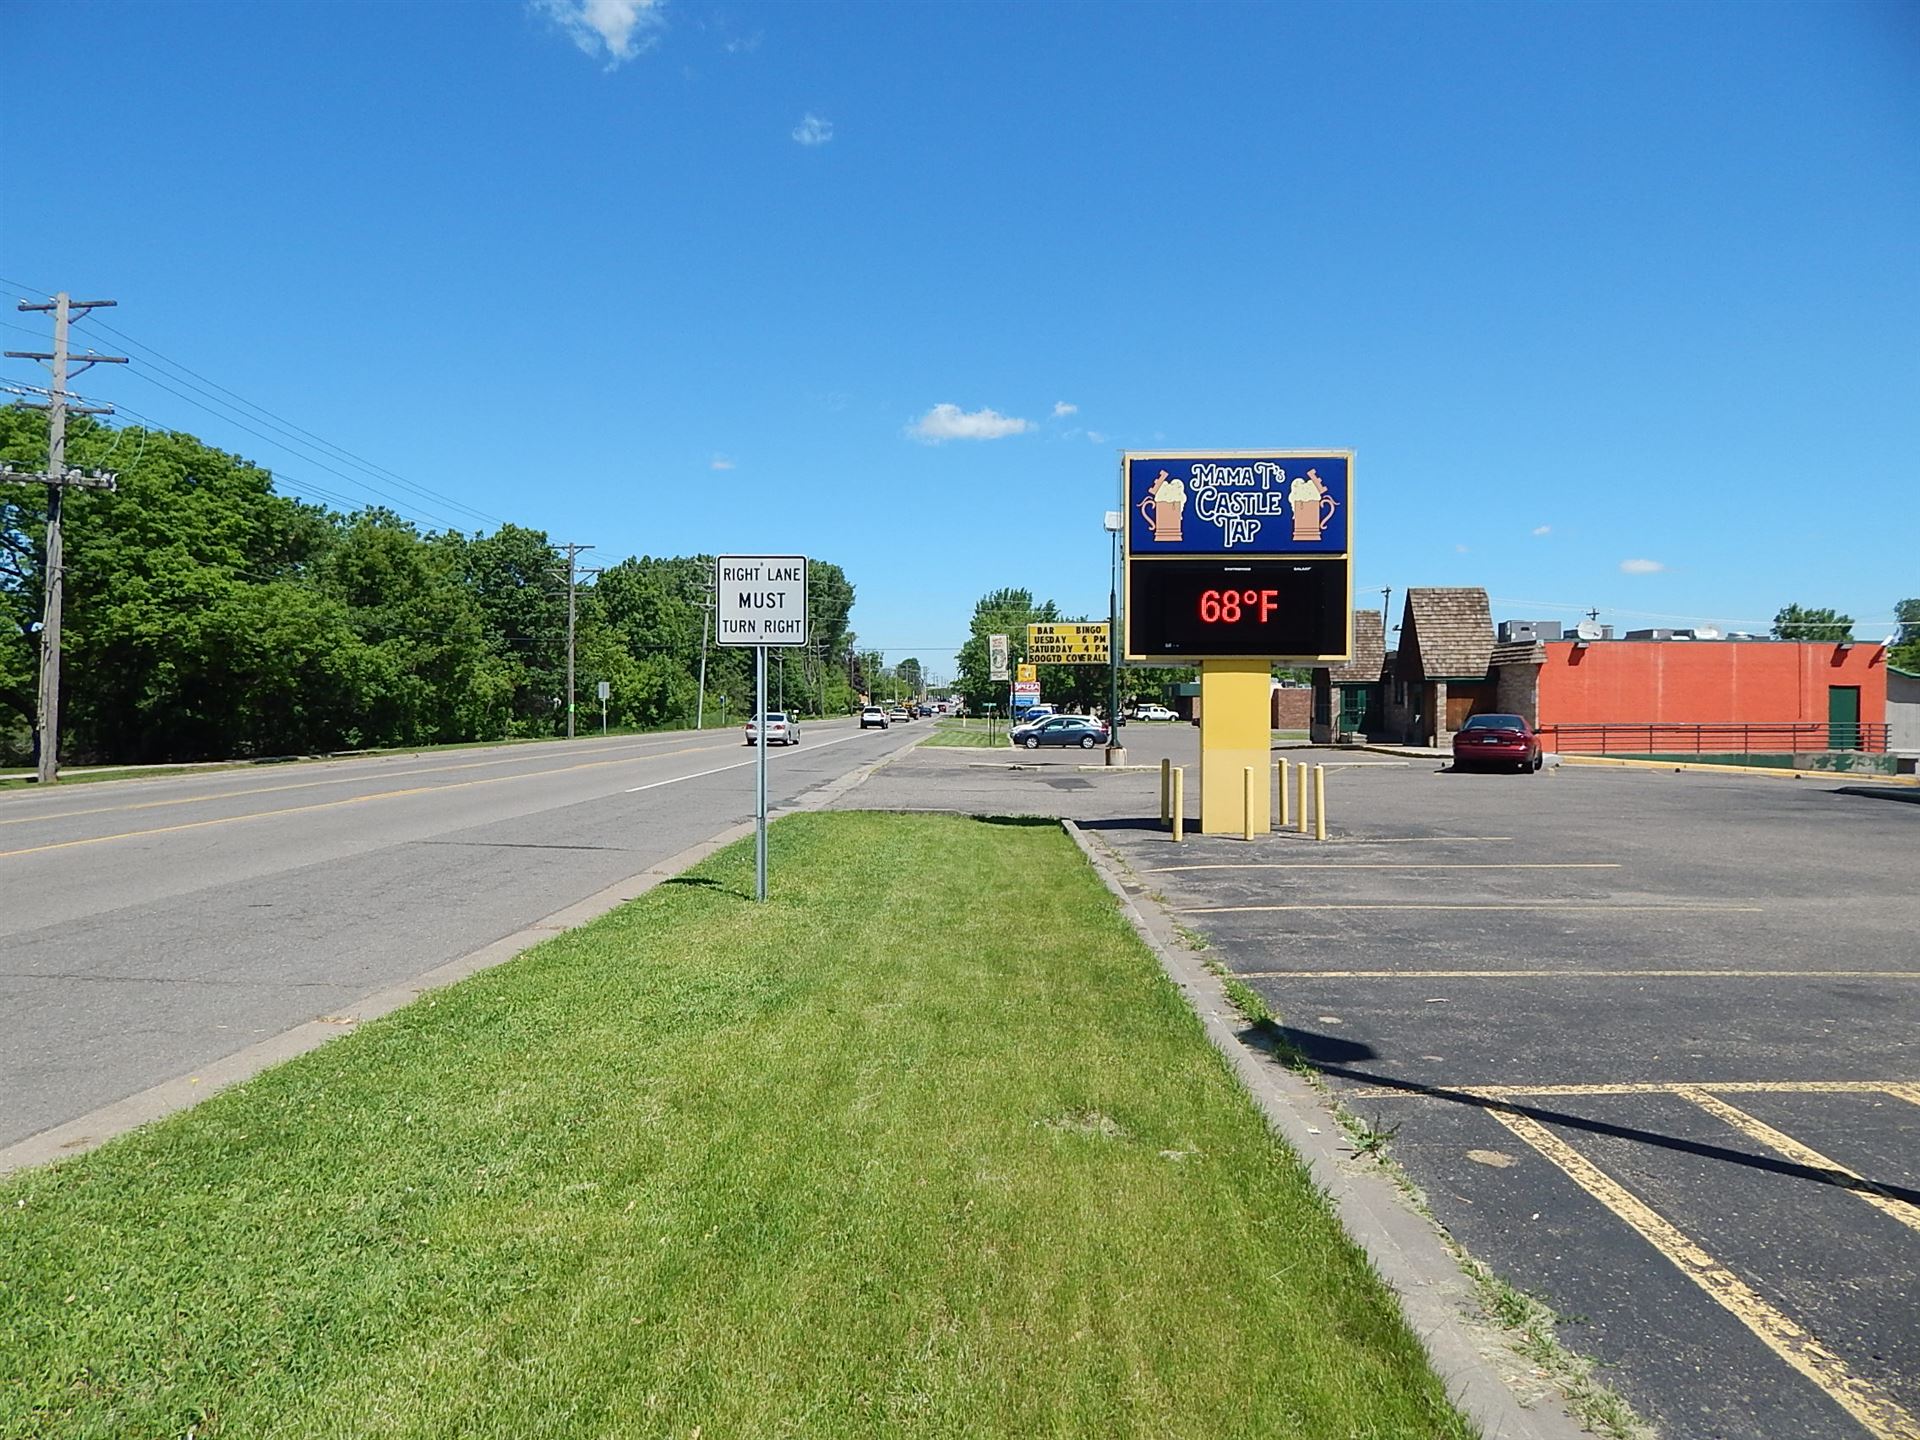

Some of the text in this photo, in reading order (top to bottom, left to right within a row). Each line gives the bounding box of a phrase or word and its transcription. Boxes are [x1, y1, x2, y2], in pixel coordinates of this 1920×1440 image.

[1195, 486, 1282, 520] CASTLE
[1213, 514, 1261, 547] TAP
[723, 568, 801, 581] RIGHT LANE
[739, 592, 786, 609] MUST
[1201, 590, 1278, 622] 68°F
[722, 620, 801, 633] TURN RIGHT
[1037, 626, 1102, 635] BAR BINGO
[1034, 635, 1106, 644] UESDAY 6 PM
[1029, 645, 1073, 653] SATURDAY
[1066, 654, 1108, 662] COVERALL
